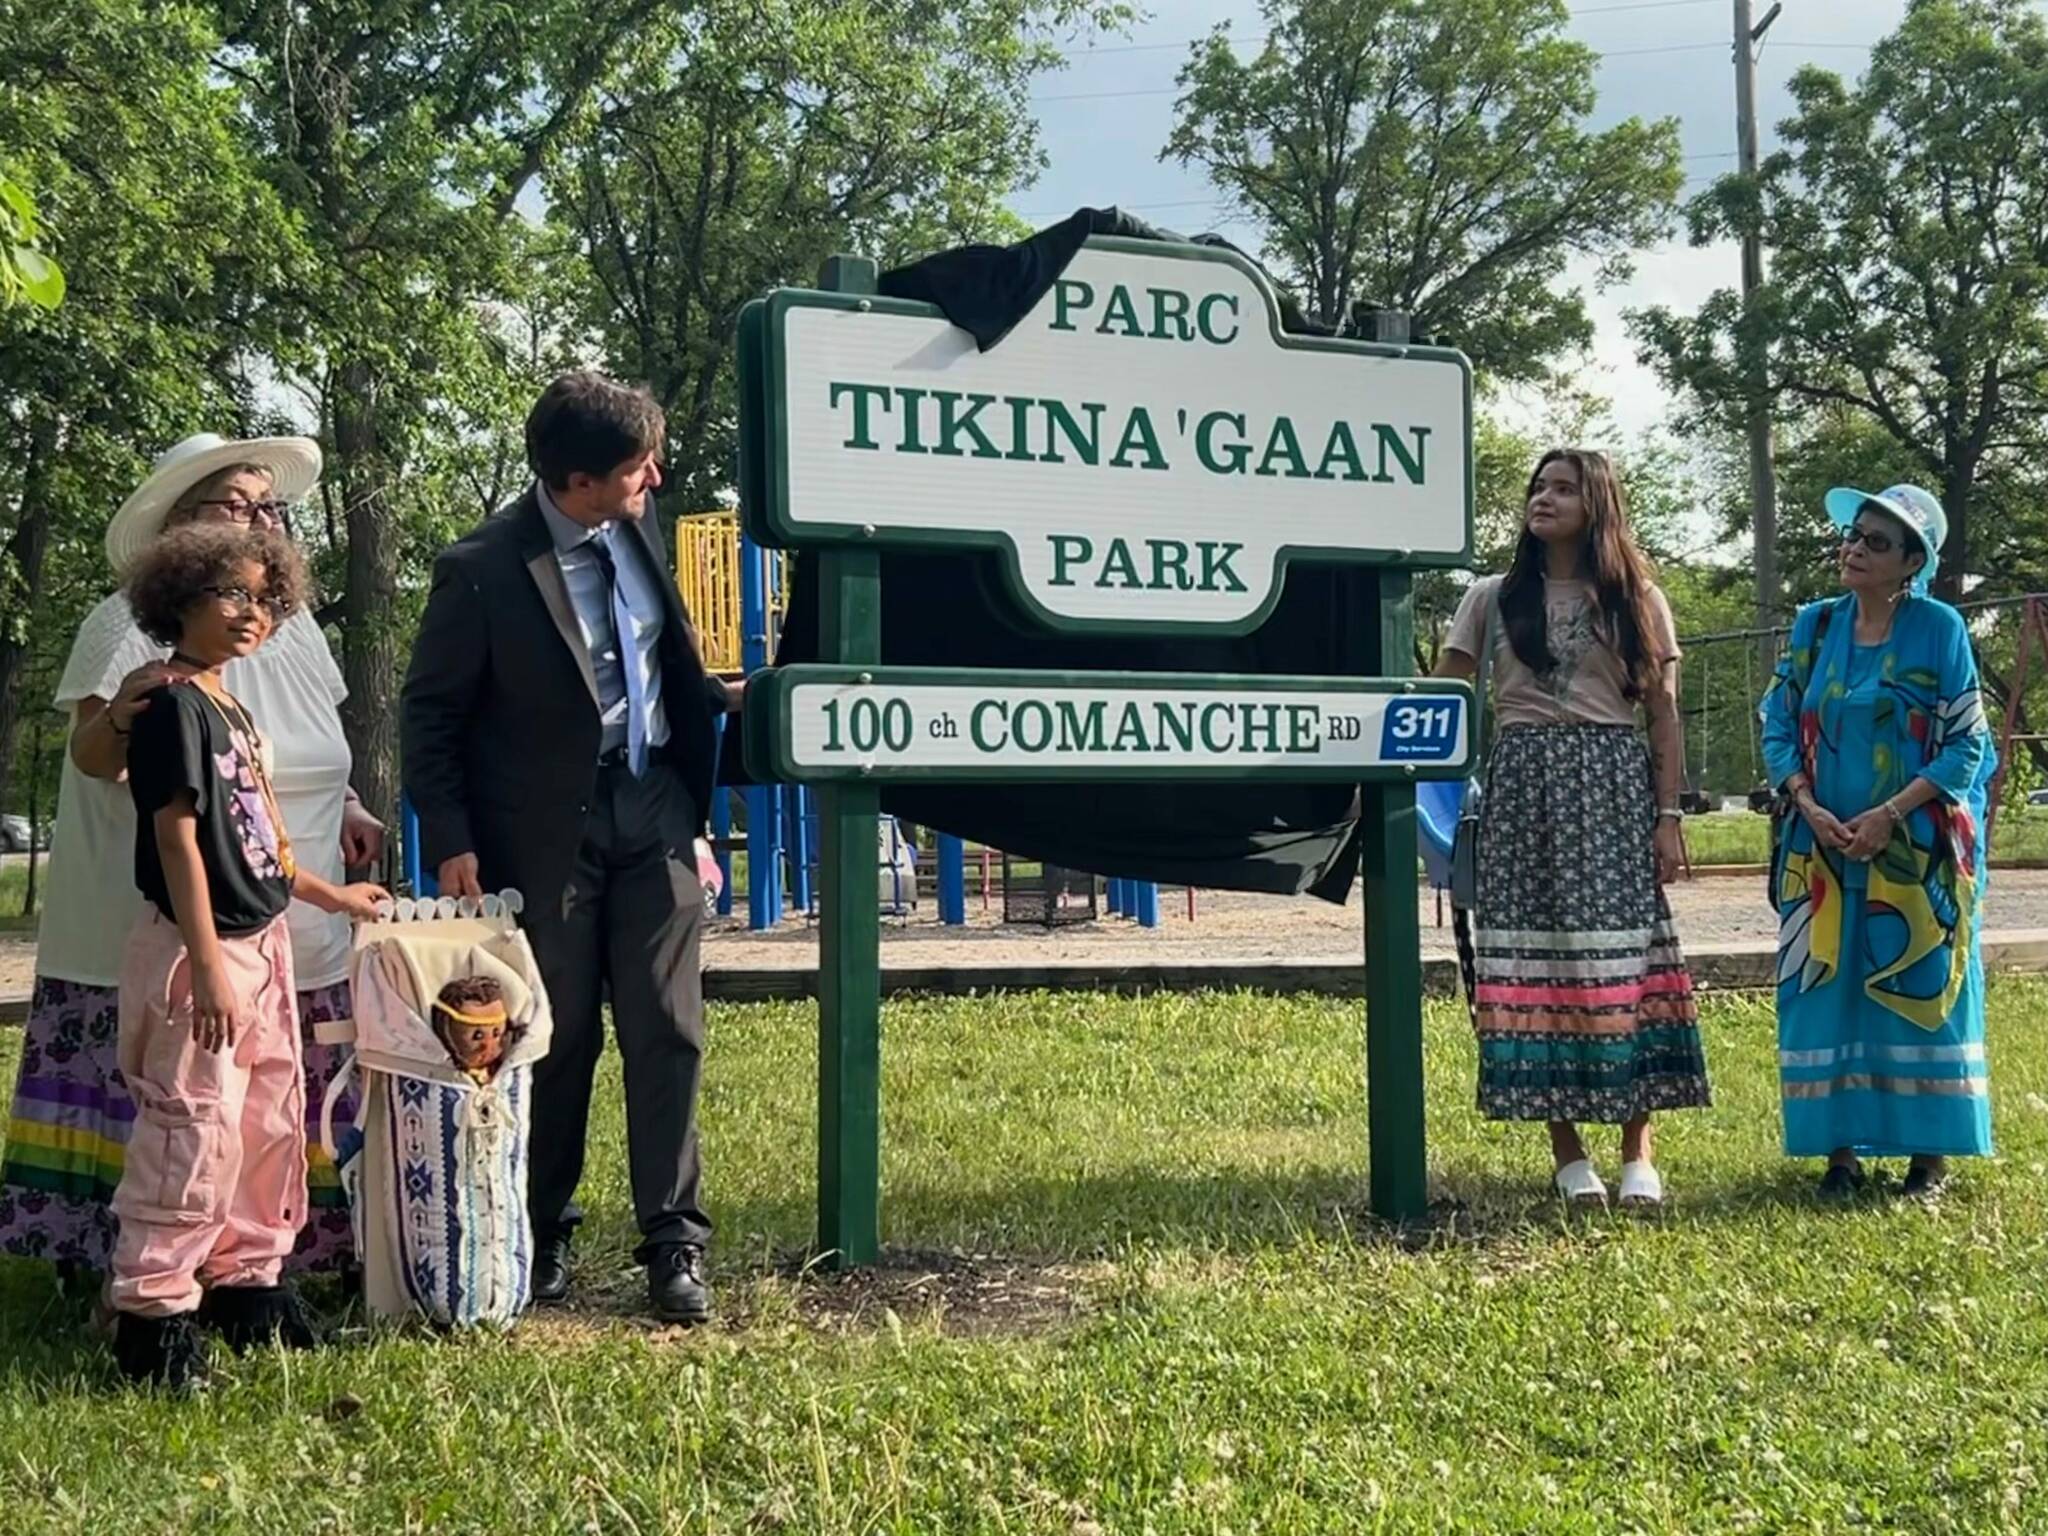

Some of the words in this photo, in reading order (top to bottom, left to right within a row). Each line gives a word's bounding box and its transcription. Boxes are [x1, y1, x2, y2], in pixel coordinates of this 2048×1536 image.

[1048, 279, 1240, 345] PARC
[829, 382, 1432, 485] TIKINA'GAAN
[1047, 534, 1248, 593] PARK
[821, 697, 913, 752] 100
[929, 712, 959, 739] ch
[969, 700, 1321, 754] COMANCHE
[1327, 717, 1362, 742] RD
[1391, 706, 1451, 738] 311
